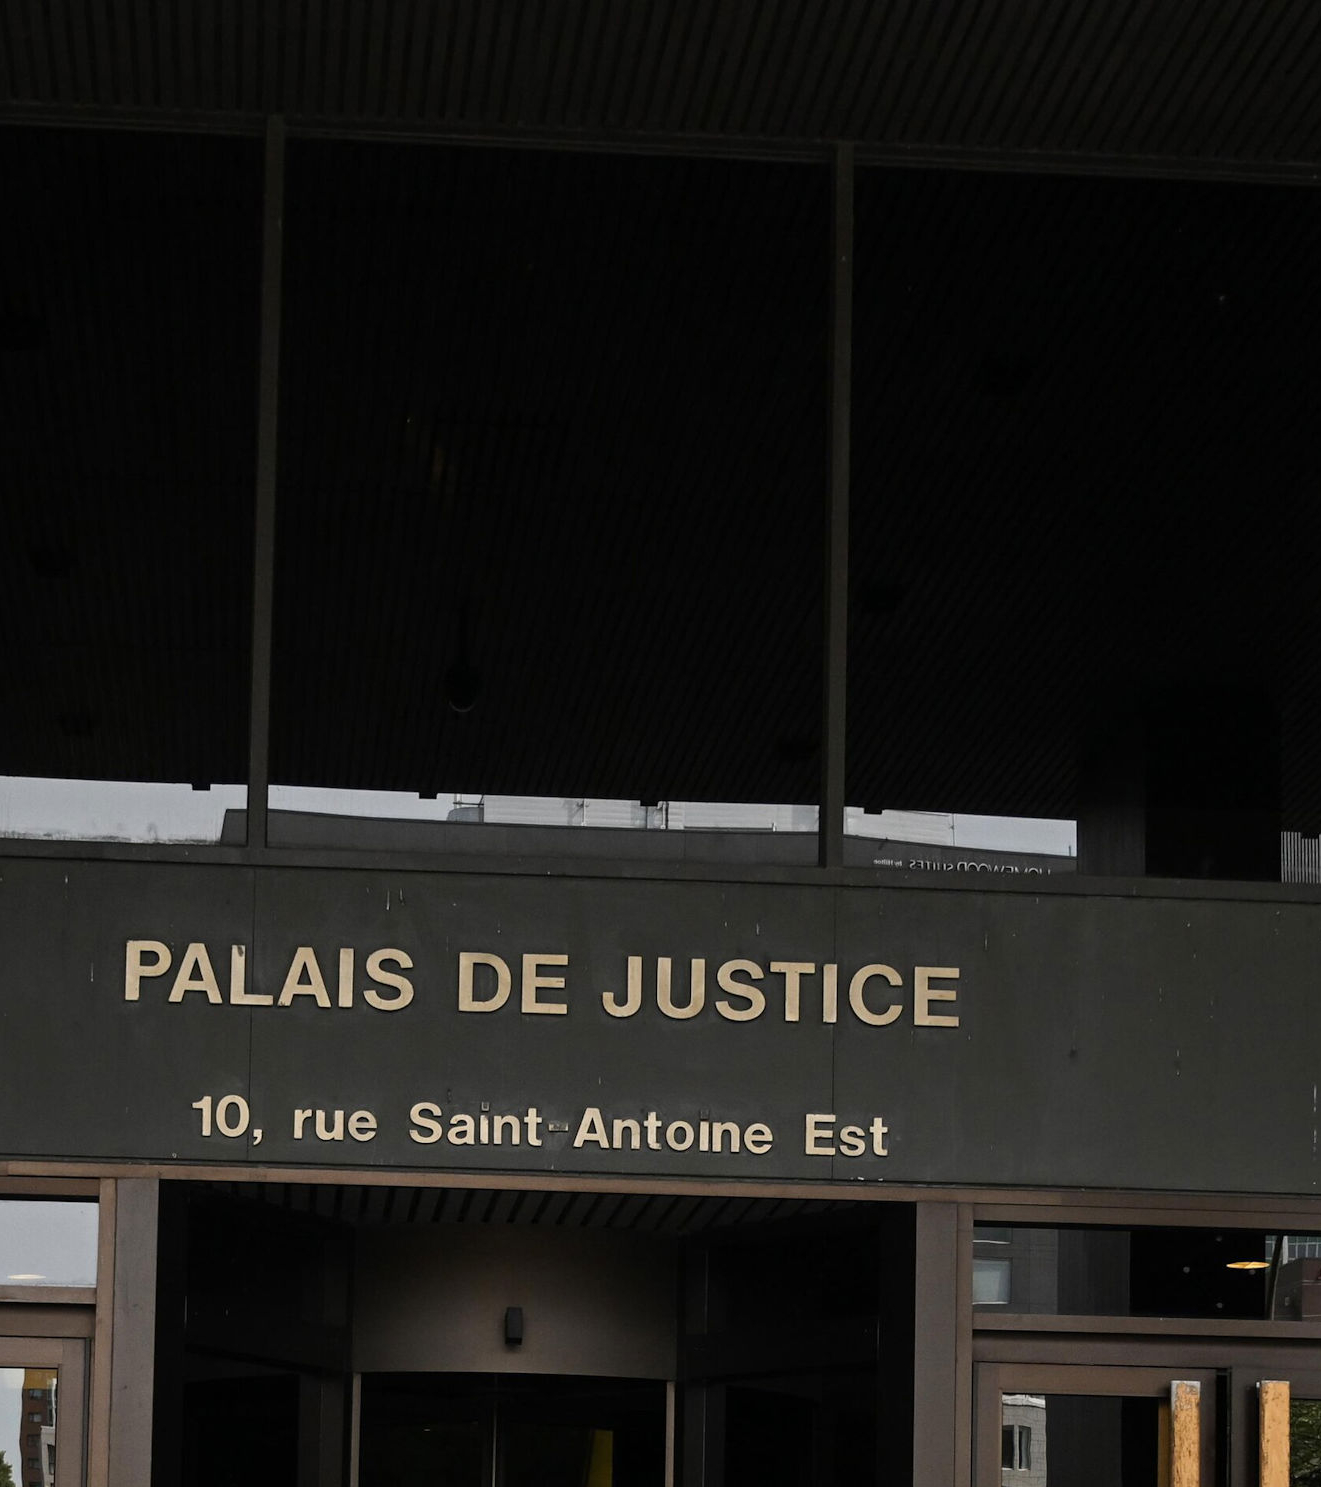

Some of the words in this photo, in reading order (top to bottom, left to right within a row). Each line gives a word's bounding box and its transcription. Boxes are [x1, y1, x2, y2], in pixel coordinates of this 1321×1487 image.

[125, 940, 415, 1011] PALAIS
[458, 952, 568, 1015] DE
[602, 956, 960, 1028] JUSTICE
[192, 1094, 264, 1146] 10,
[294, 1108, 377, 1142] rue
[804, 1114, 888, 1156] Est
